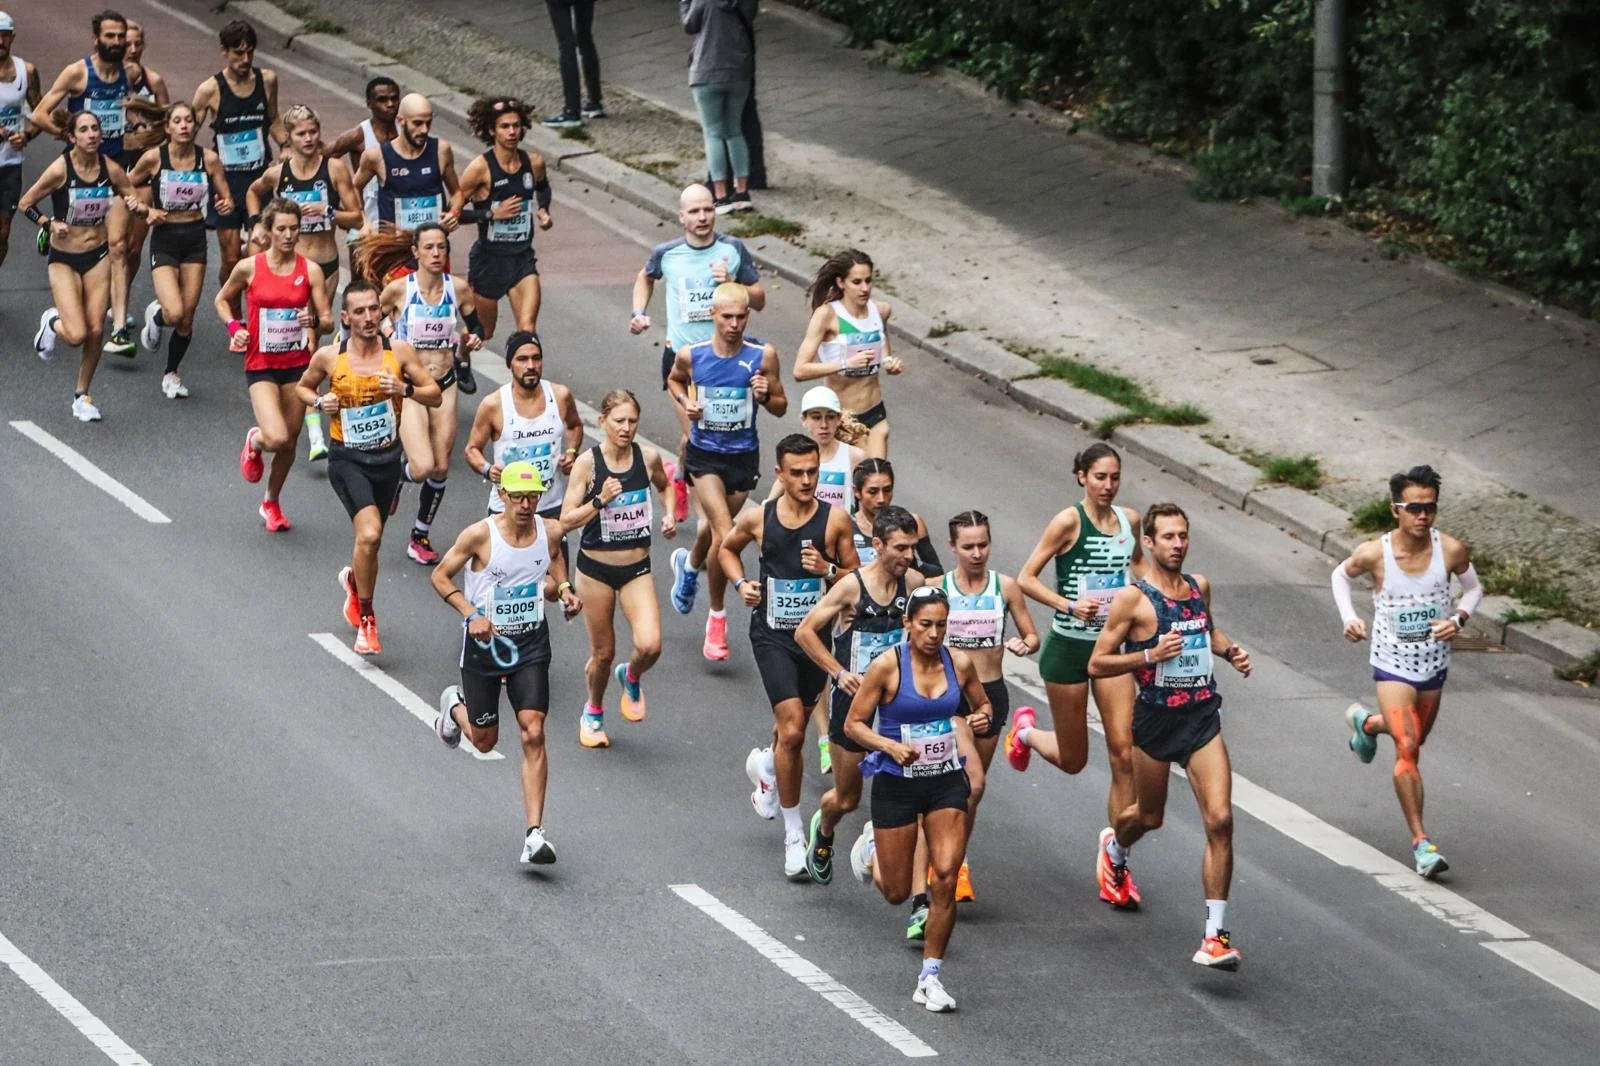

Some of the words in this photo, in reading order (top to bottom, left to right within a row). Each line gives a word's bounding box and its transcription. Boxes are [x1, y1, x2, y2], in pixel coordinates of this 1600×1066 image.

[425, 323, 444, 332] F49
[712, 403, 740, 415] TRISTAN
[351, 418, 387, 434] 15632
[613, 508, 645, 522] PALM
[495, 601, 535, 615] 63009
[776, 595, 817, 608] 32544
[507, 615, 525, 623] JUAN
[1399, 608, 1436, 623] 61790
[1179, 654, 1200, 668] SIMON
[924, 742, 946, 755] F63
